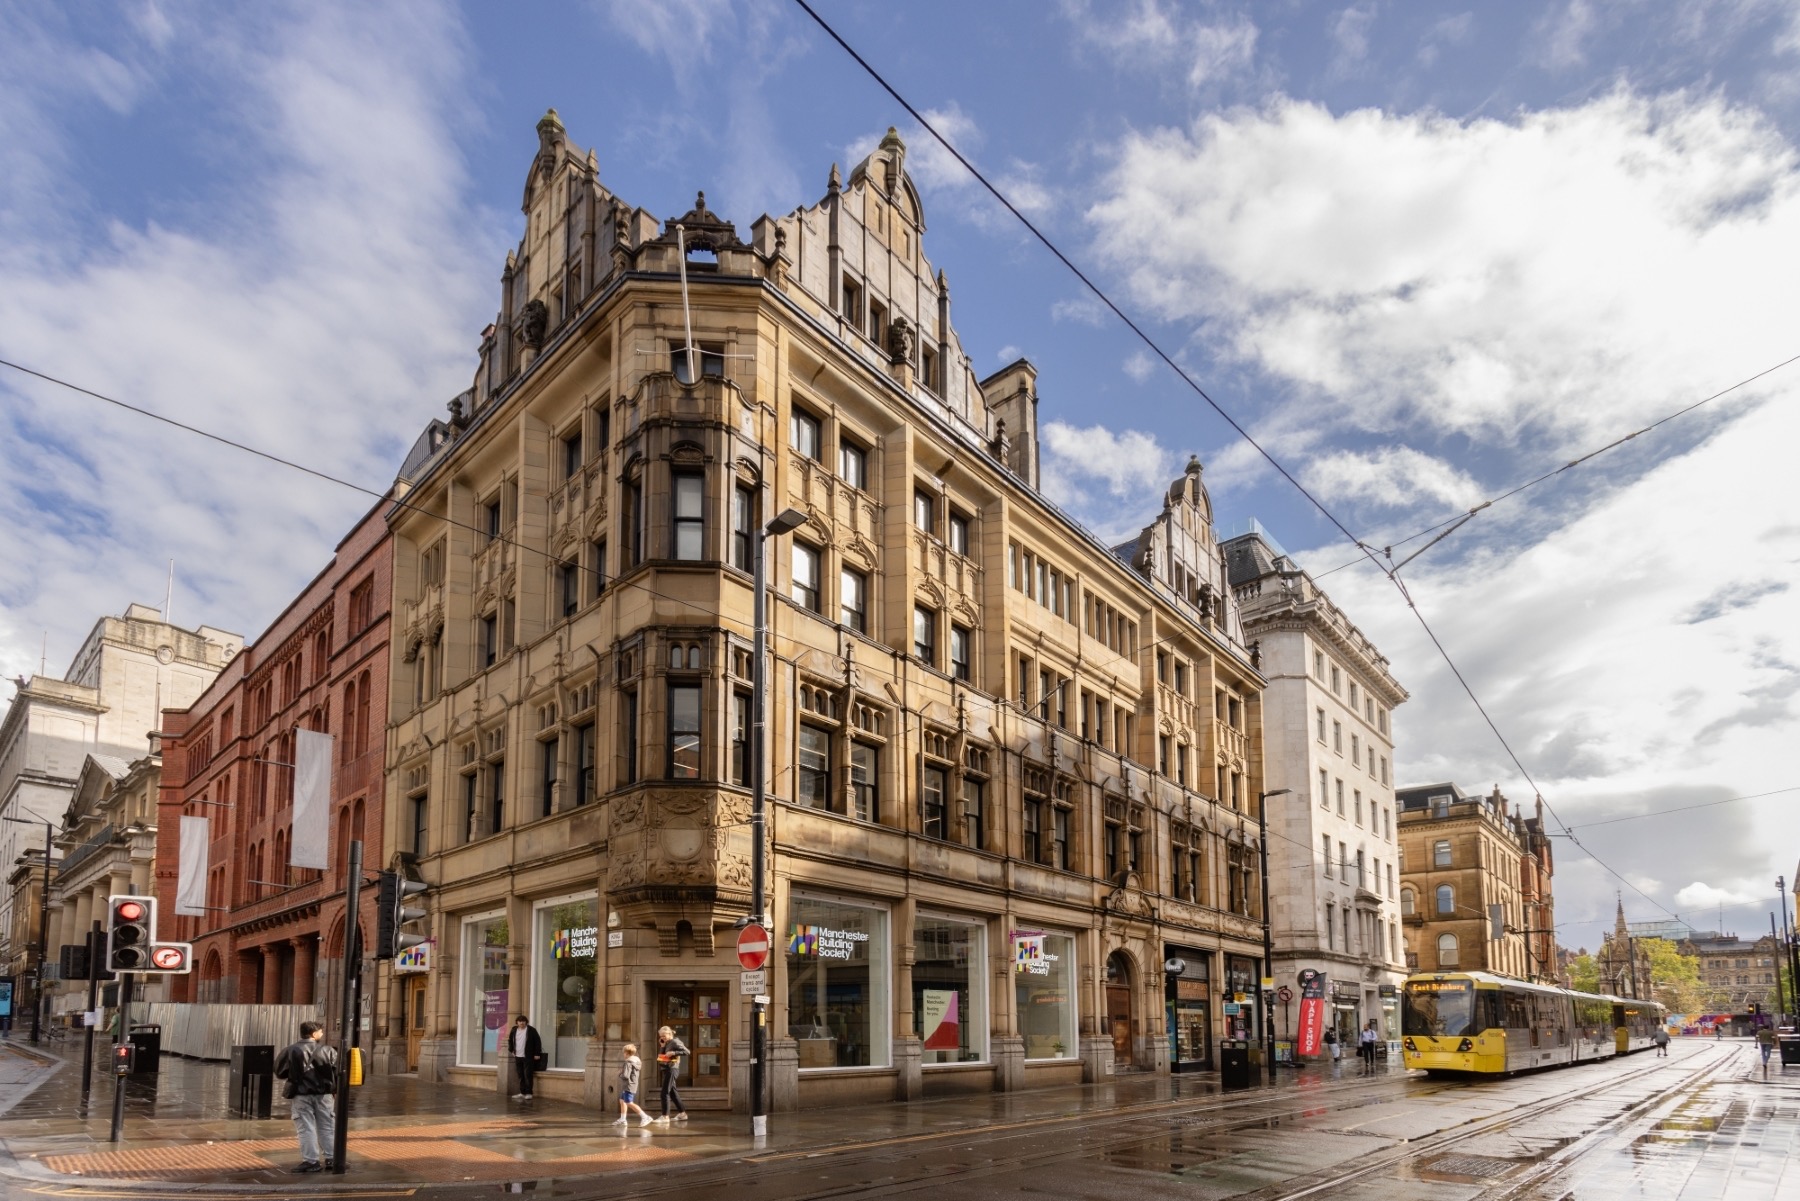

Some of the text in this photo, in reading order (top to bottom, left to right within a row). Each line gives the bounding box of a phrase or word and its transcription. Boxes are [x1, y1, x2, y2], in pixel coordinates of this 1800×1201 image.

[819, 927, 868, 941] Manchester
[571, 937, 597, 948] Building
[819, 937, 854, 951] Building
[571, 946, 596, 958] Society
[819, 947, 850, 960] Society
[1029, 967, 1048, 976] Society
[1431, 983, 1466, 991] Didsbury
[1307, 1000, 1315, 1025] VAPE
[1305, 1027, 1313, 1052] SHOP
